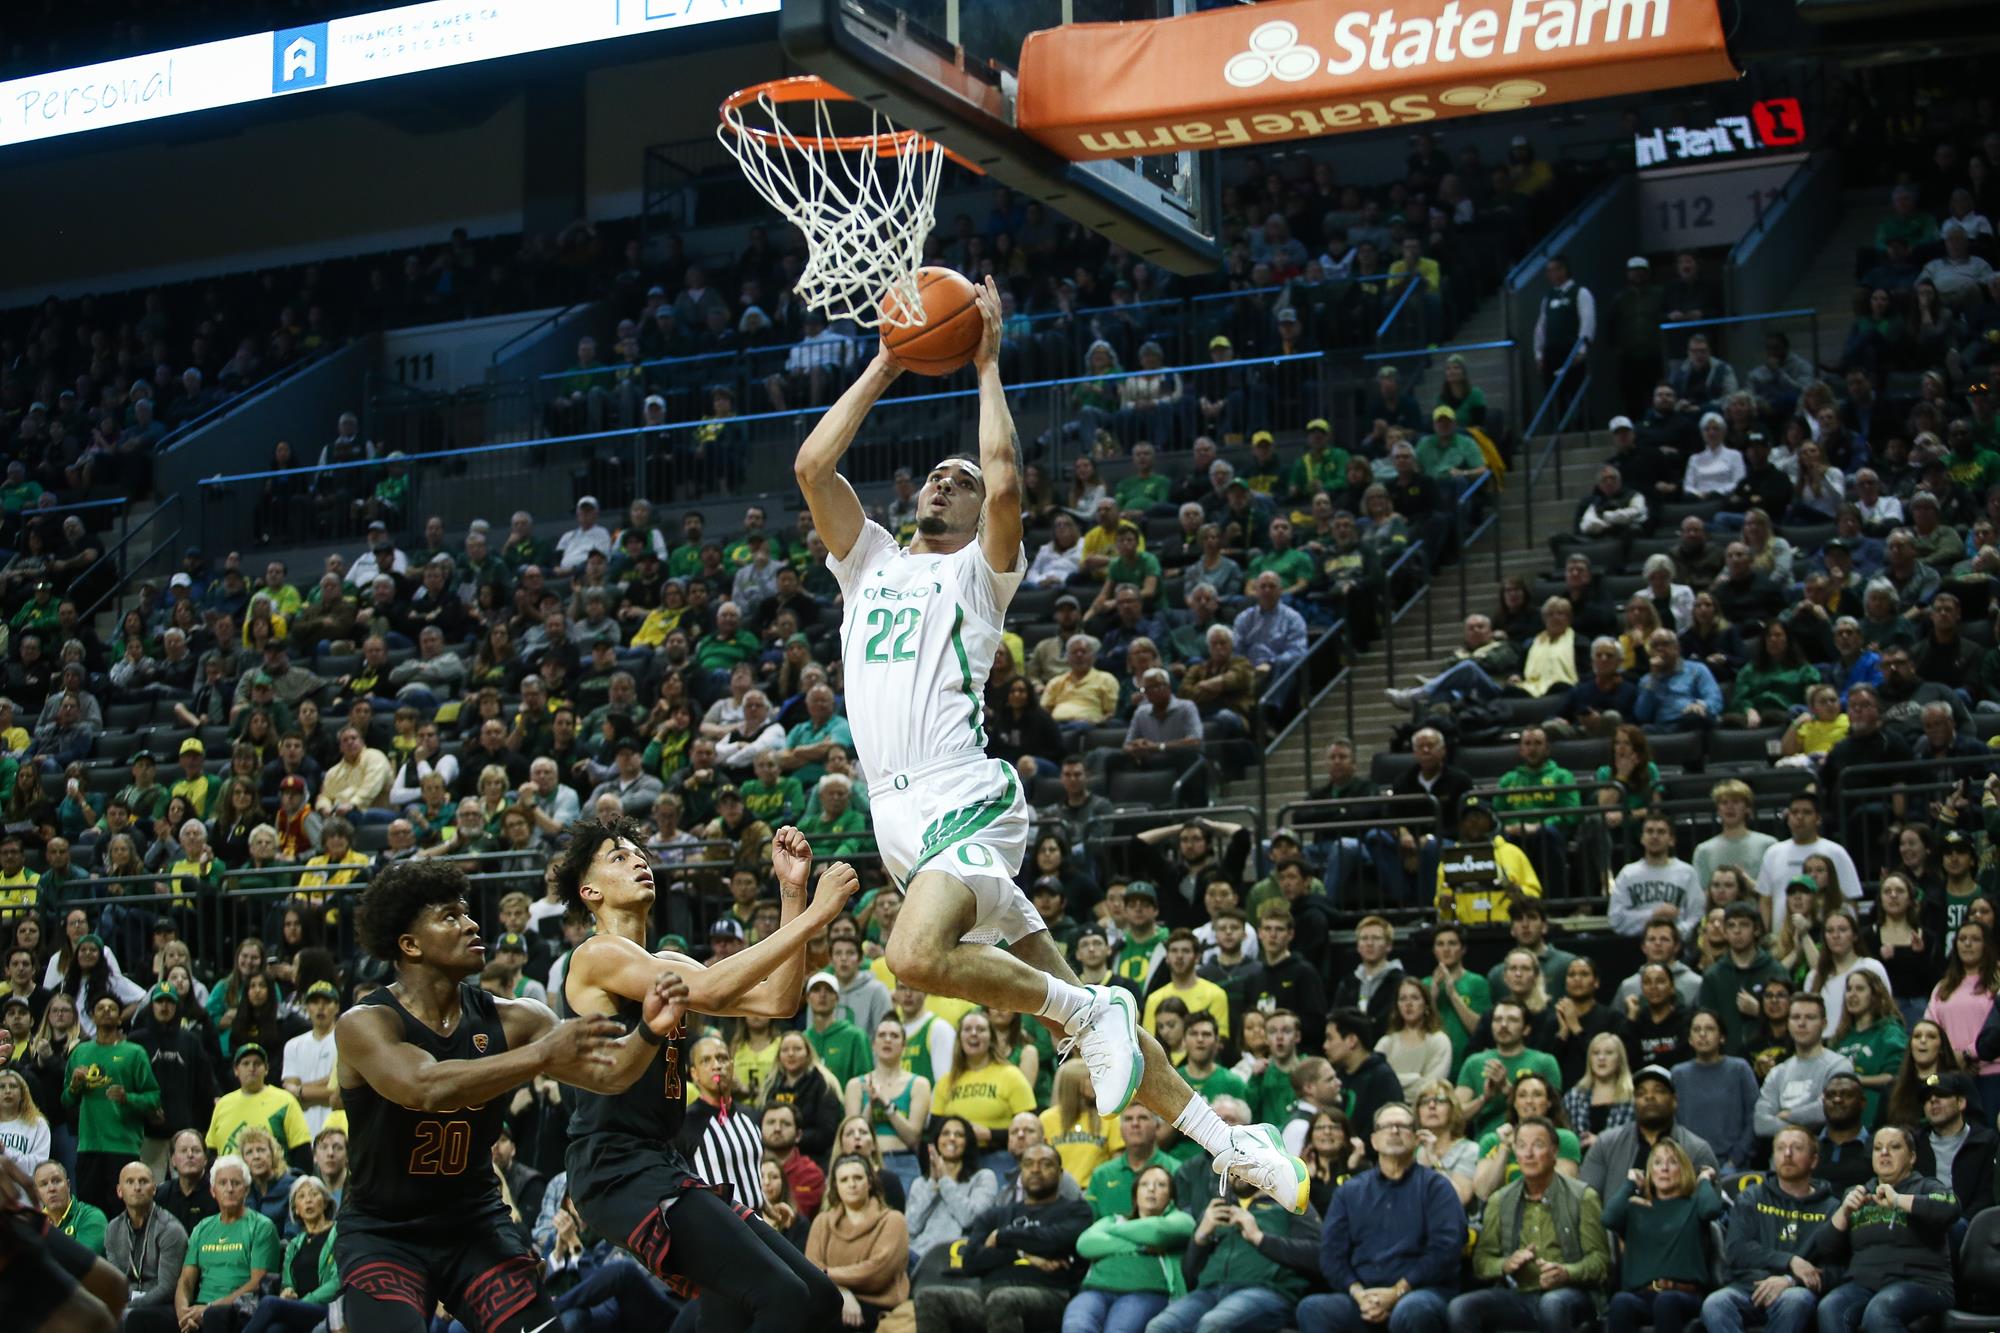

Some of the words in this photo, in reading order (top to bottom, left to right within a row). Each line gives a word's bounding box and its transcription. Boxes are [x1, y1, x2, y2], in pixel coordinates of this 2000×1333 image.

[15, 57, 174, 126] Personal
[1657, 195, 1715, 231] 112
[395, 351, 435, 382] 111
[865, 607, 922, 664] 22
[408, 1120, 471, 1175] 20
